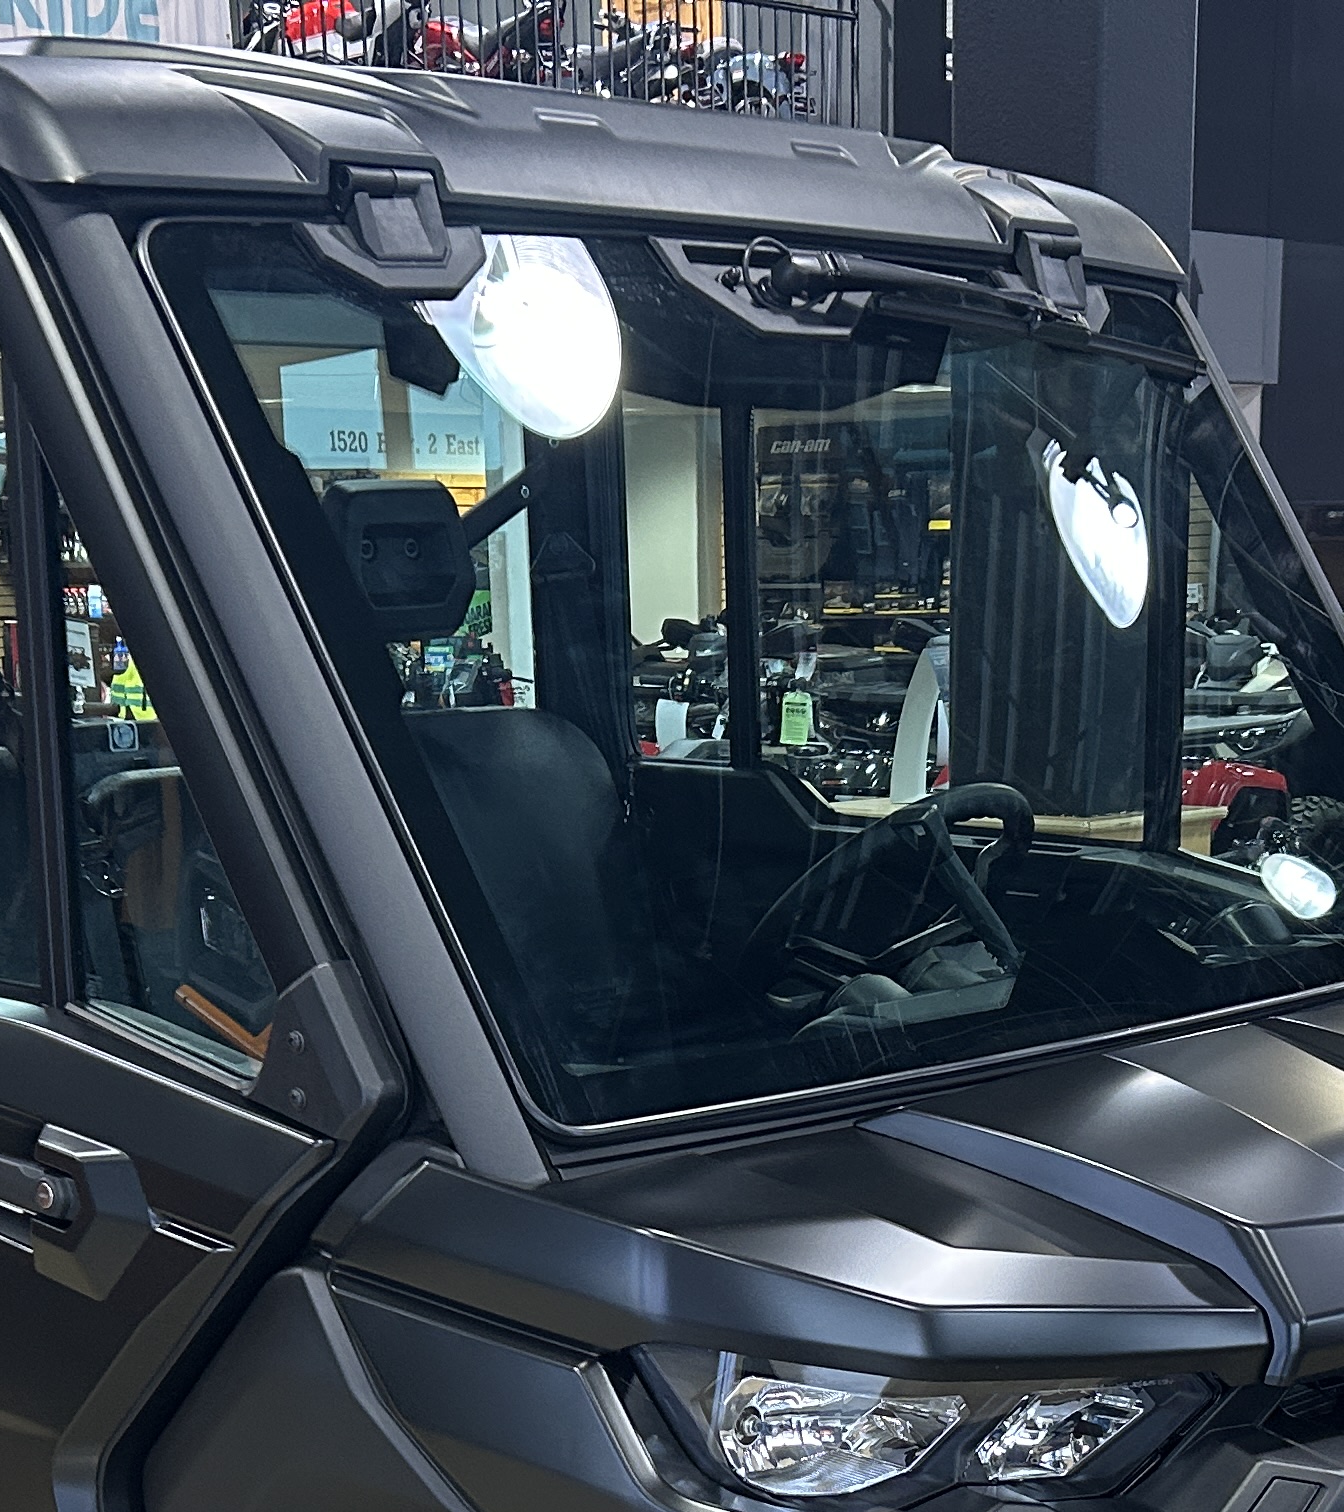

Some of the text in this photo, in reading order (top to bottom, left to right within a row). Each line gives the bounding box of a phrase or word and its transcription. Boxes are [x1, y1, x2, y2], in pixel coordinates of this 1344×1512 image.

[329, 430, 369, 454] 1520
[427, 432, 439, 455] 2
[445, 433, 481, 456] East
[770, 438, 831, 455] can-am
